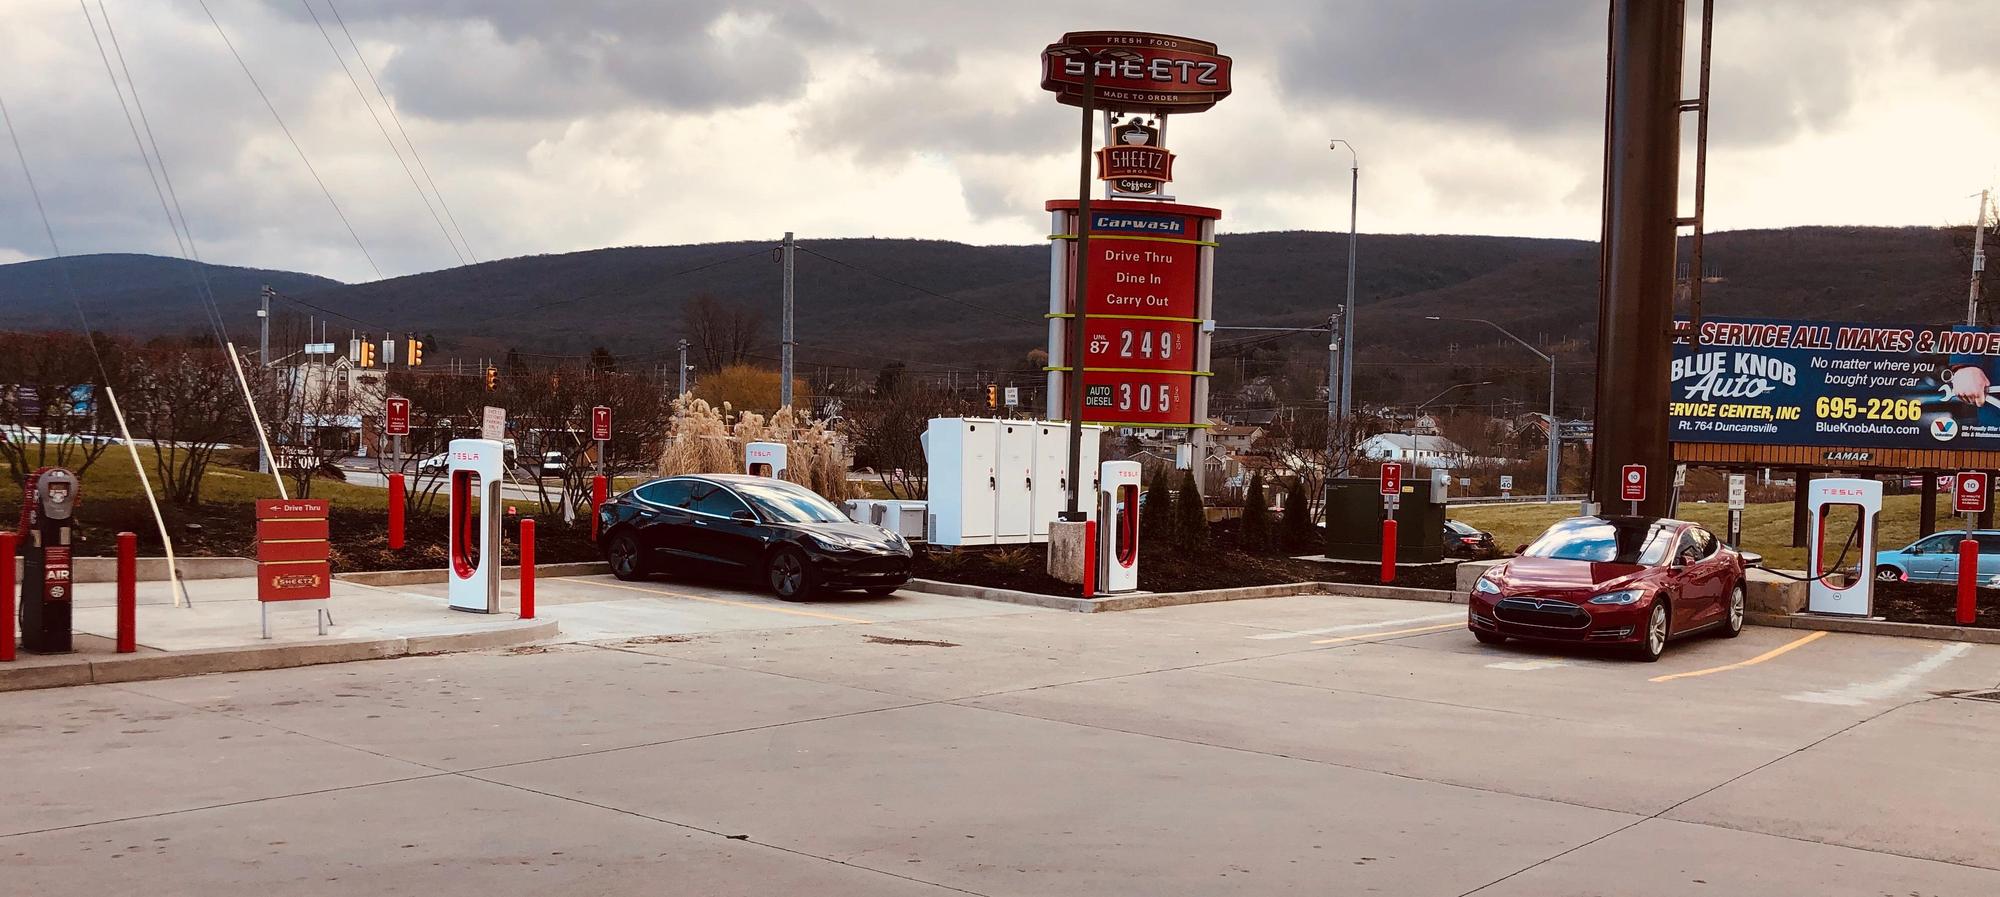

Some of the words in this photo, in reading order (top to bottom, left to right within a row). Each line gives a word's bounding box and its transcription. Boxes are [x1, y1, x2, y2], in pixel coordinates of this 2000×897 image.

[1150, 39, 1178, 48] FOOD
[1065, 56, 1217, 84] SHEETZ
[1104, 90, 1129, 99] MADE
[1112, 150, 1163, 170] SHEETZ
[1097, 217, 1180, 231] Carwash
[1105, 250, 1140, 261] Drive
[1144, 251, 1172, 263] Thru
[1116, 272, 1146, 284] Dine
[1150, 273, 1161, 284] In
[1106, 294, 1142, 307] Carry
[1146, 295, 1169, 306] Out
[1699, 322, 1792, 348] SERVICE
[1790, 325, 1832, 350] ALL
[1836, 327, 1914, 353] MAKES
[1915, 330, 1936, 354] &
[1090, 341, 1110, 354] 87
[1670, 352, 1726, 382] BLUE
[1734, 352, 1797, 387] KNOB
[1810, 356, 1828, 369] No
[1831, 358, 1871, 370] matter
[1873, 360, 1910, 371] where
[1911, 362, 1935, 375] you
[1684, 371, 1776, 402] Auto
[1824, 373, 1868, 386] bought
[1868, 376, 1896, 388] your
[1900, 378, 1919, 387] car
[1090, 386, 1110, 395] AUTO
[1086, 396, 1112, 406] DIESEL
[1719, 404, 1774, 422] CENTER,
[1776, 406, 1801, 420] INC
[1816, 396, 1922, 421] 695-2266
[1678, 421, 1693, 430] Rt.
[1694, 421, 1713, 431] 764
[1715, 423, 1778, 433] Duncansville
[1815, 422, 1920, 435] BlueKnobAuto.com
[1827, 452, 1869, 461] LAMAR
[46, 570, 69, 580] AIR
